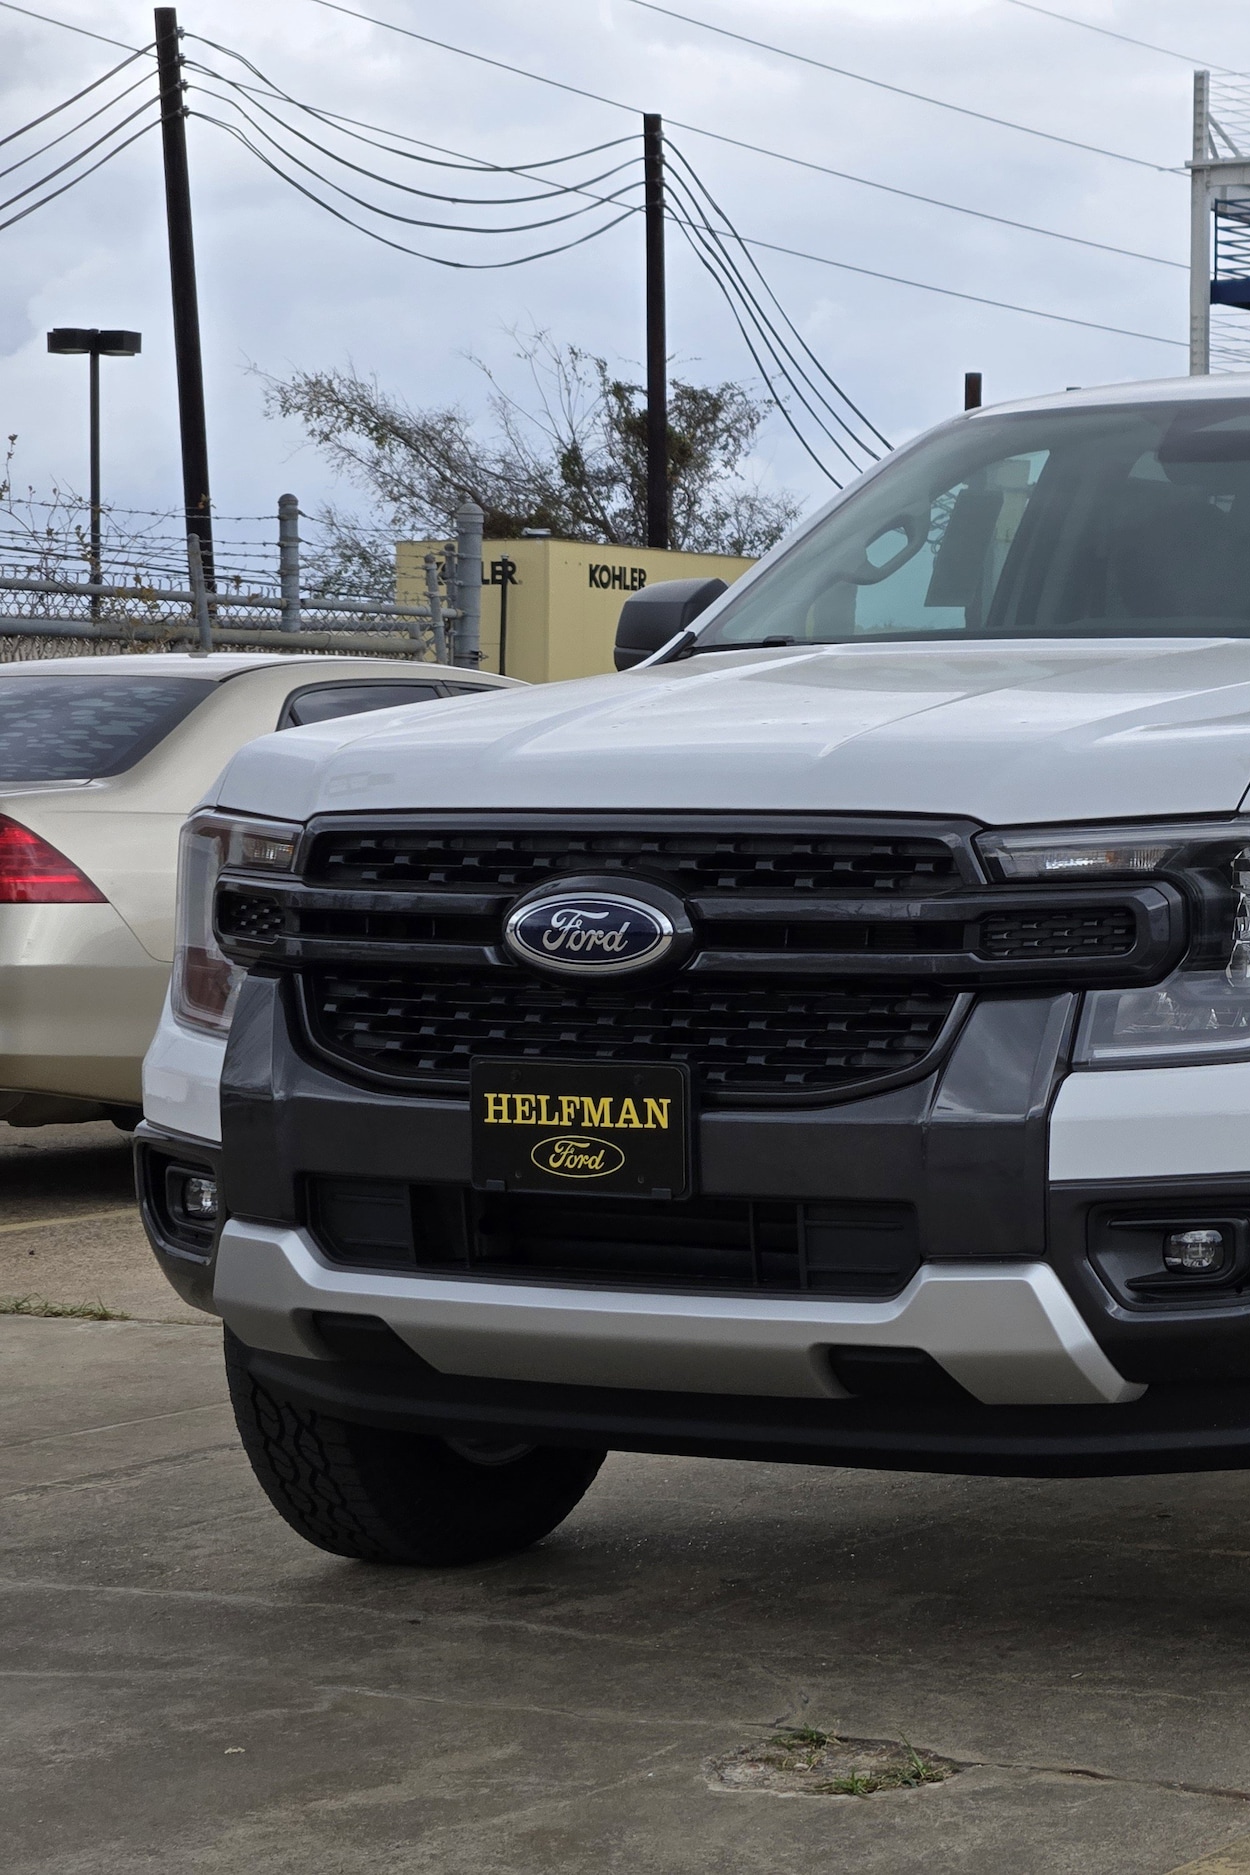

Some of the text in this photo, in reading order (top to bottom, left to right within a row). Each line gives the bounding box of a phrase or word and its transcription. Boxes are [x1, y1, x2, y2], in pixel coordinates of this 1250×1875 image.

[588, 563, 647, 591] KOHLER
[542, 908, 630, 952] Ford
[483, 1092, 672, 1130] HELFMAN
[549, 1139, 605, 1171] Ford
